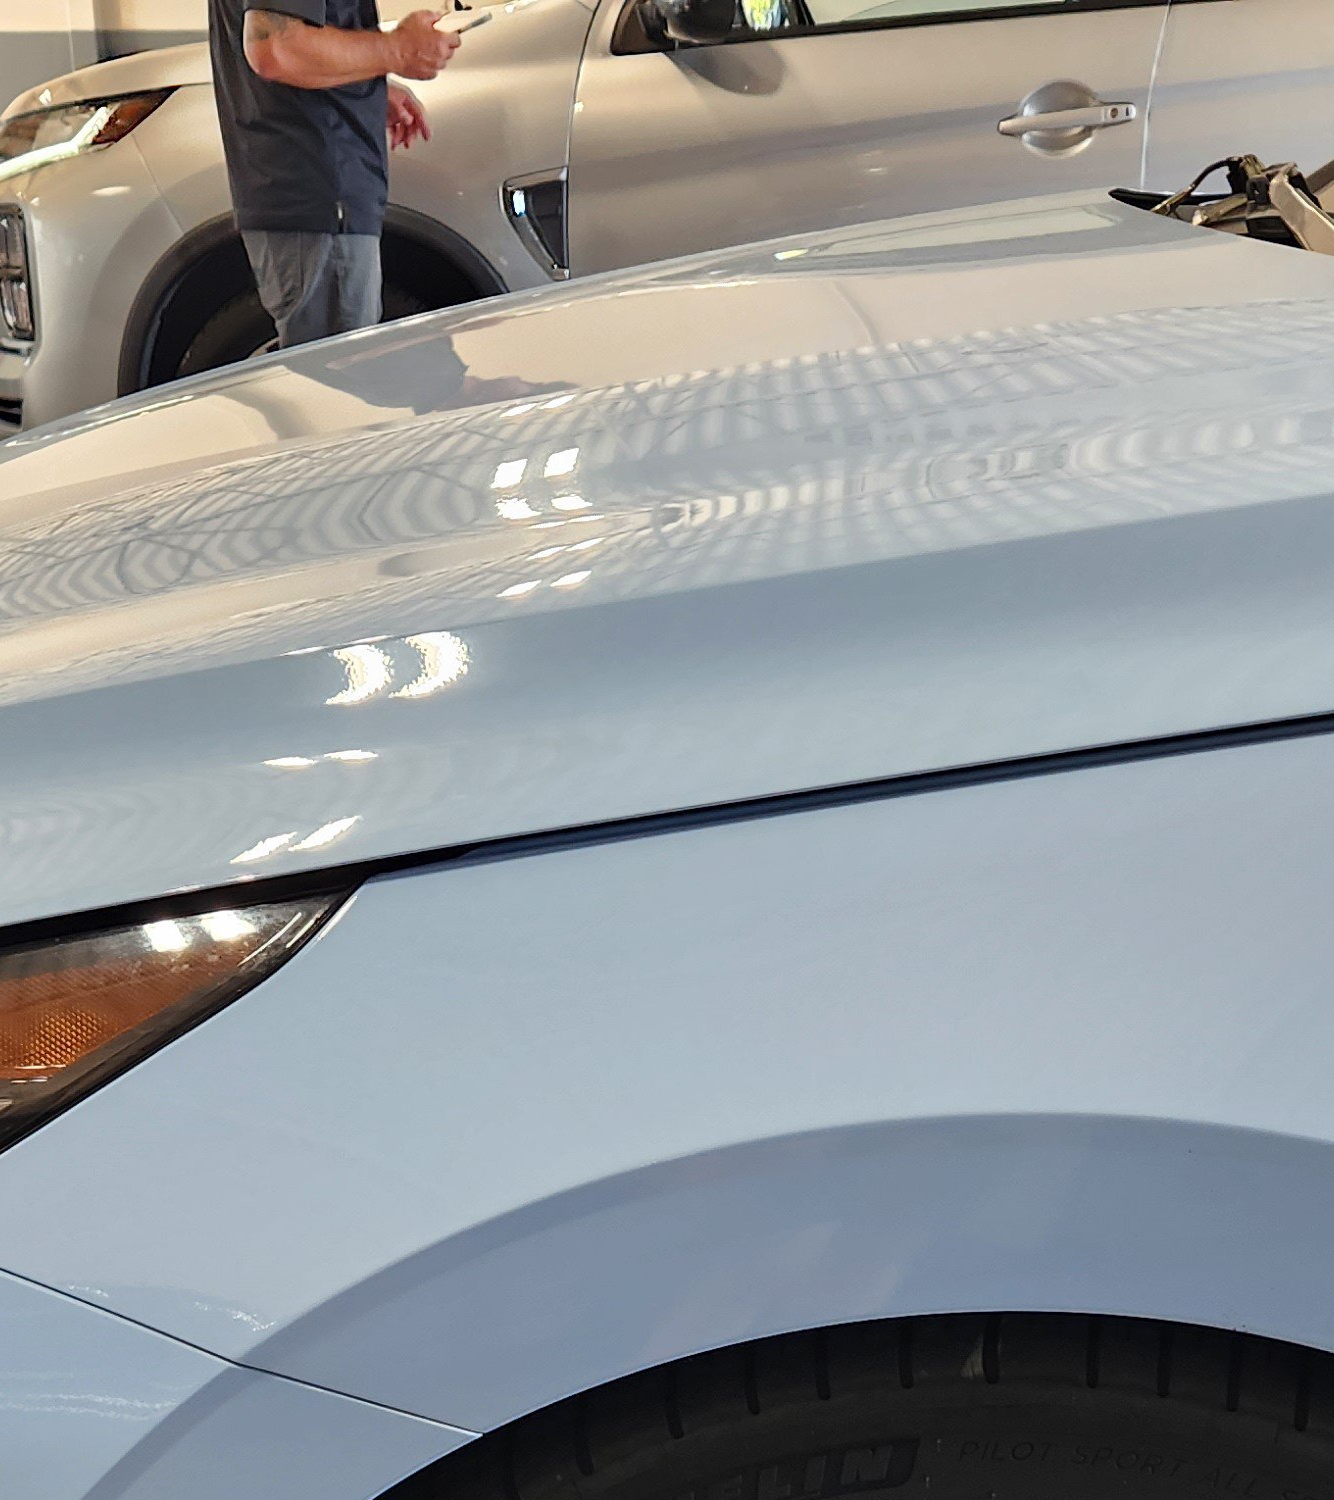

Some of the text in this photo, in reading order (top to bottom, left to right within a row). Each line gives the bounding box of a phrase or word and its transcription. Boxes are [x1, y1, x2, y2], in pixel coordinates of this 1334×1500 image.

[957, 1440, 1059, 1463] PILOT
[1070, 1445, 1190, 1478] SPORT
[1196, 1466, 1259, 1498] ALL
